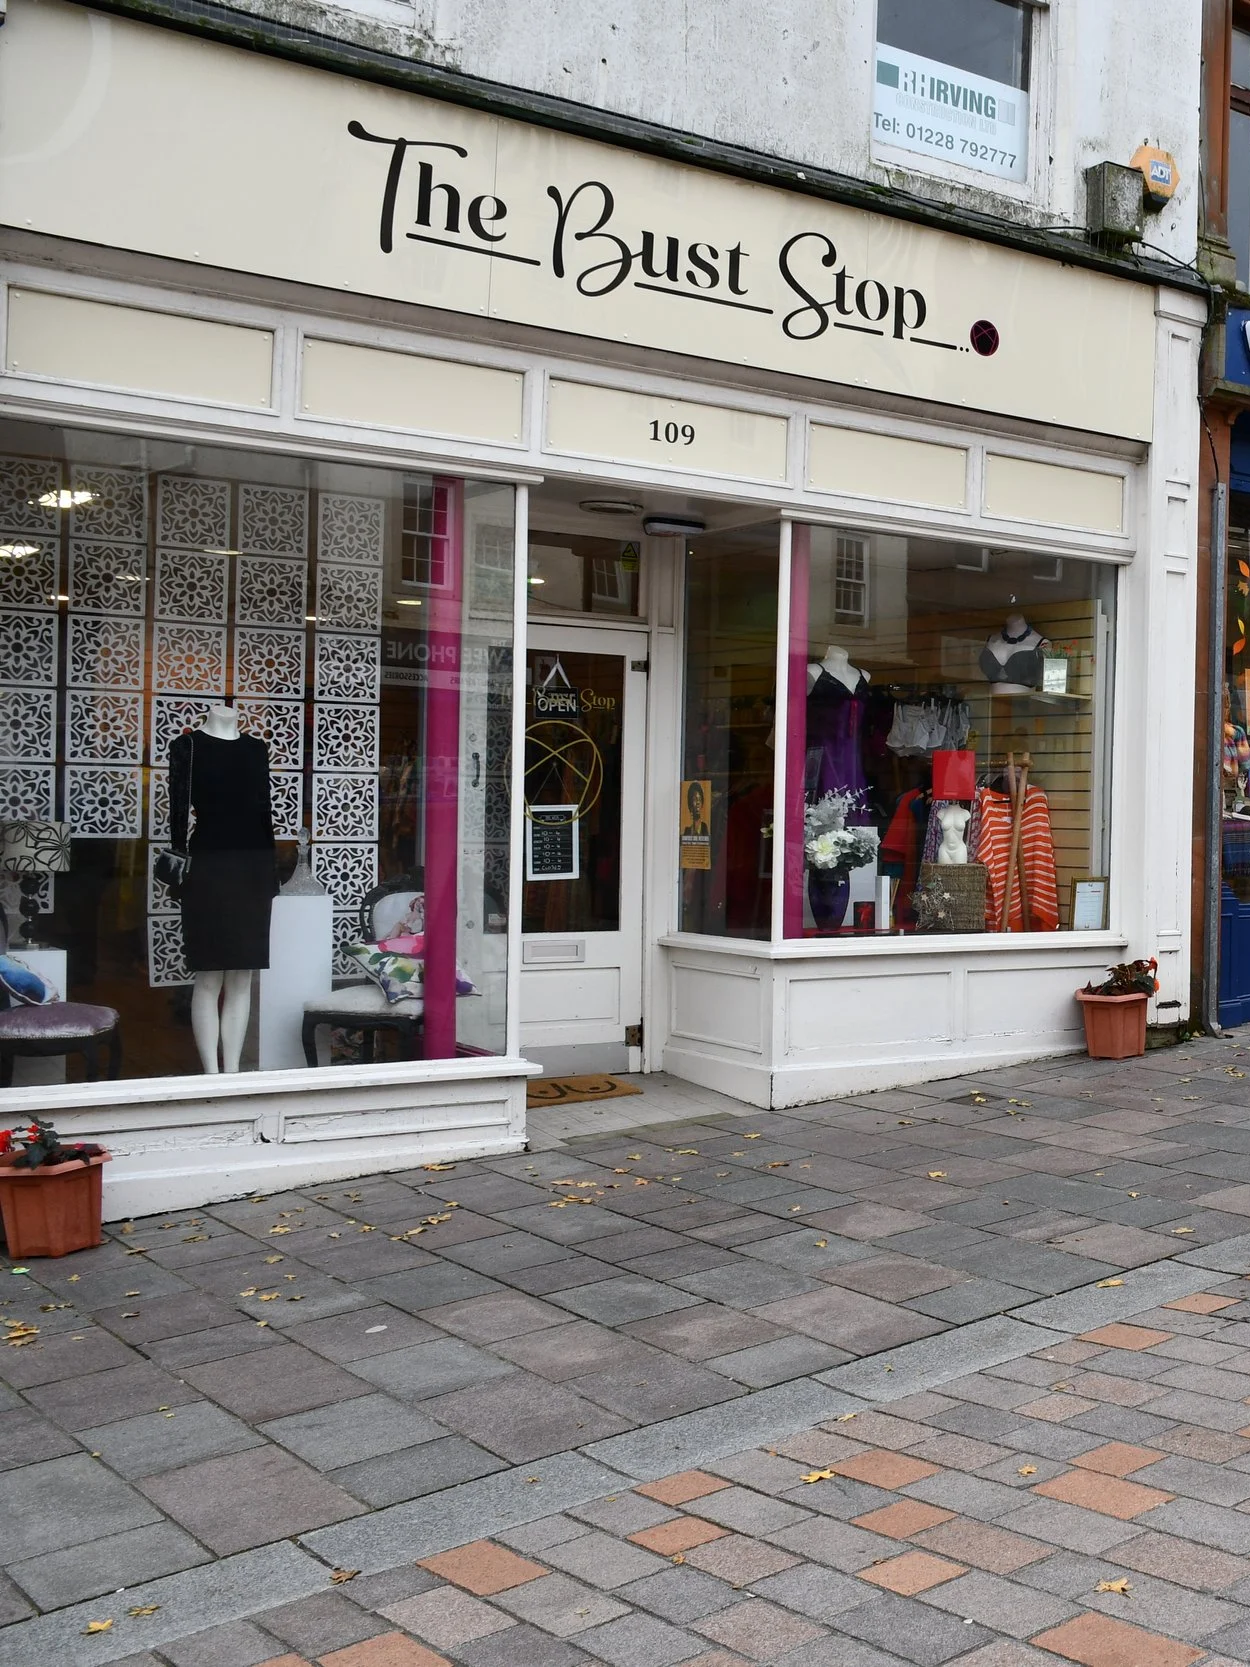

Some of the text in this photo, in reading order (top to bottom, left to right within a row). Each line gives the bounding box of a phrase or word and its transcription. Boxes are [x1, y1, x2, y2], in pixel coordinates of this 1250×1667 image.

[895, 92, 997, 136] CONSTRUCTION LTD
[873, 111, 1017, 168] Tel: 01228 792777
[1151, 165, 1170, 181] ADT
[347, 119, 927, 341] The Bust Stop
[649, 419, 695, 446] 109
[537, 697, 577, 713] OPEN
[580, 688, 616, 713] Stop
